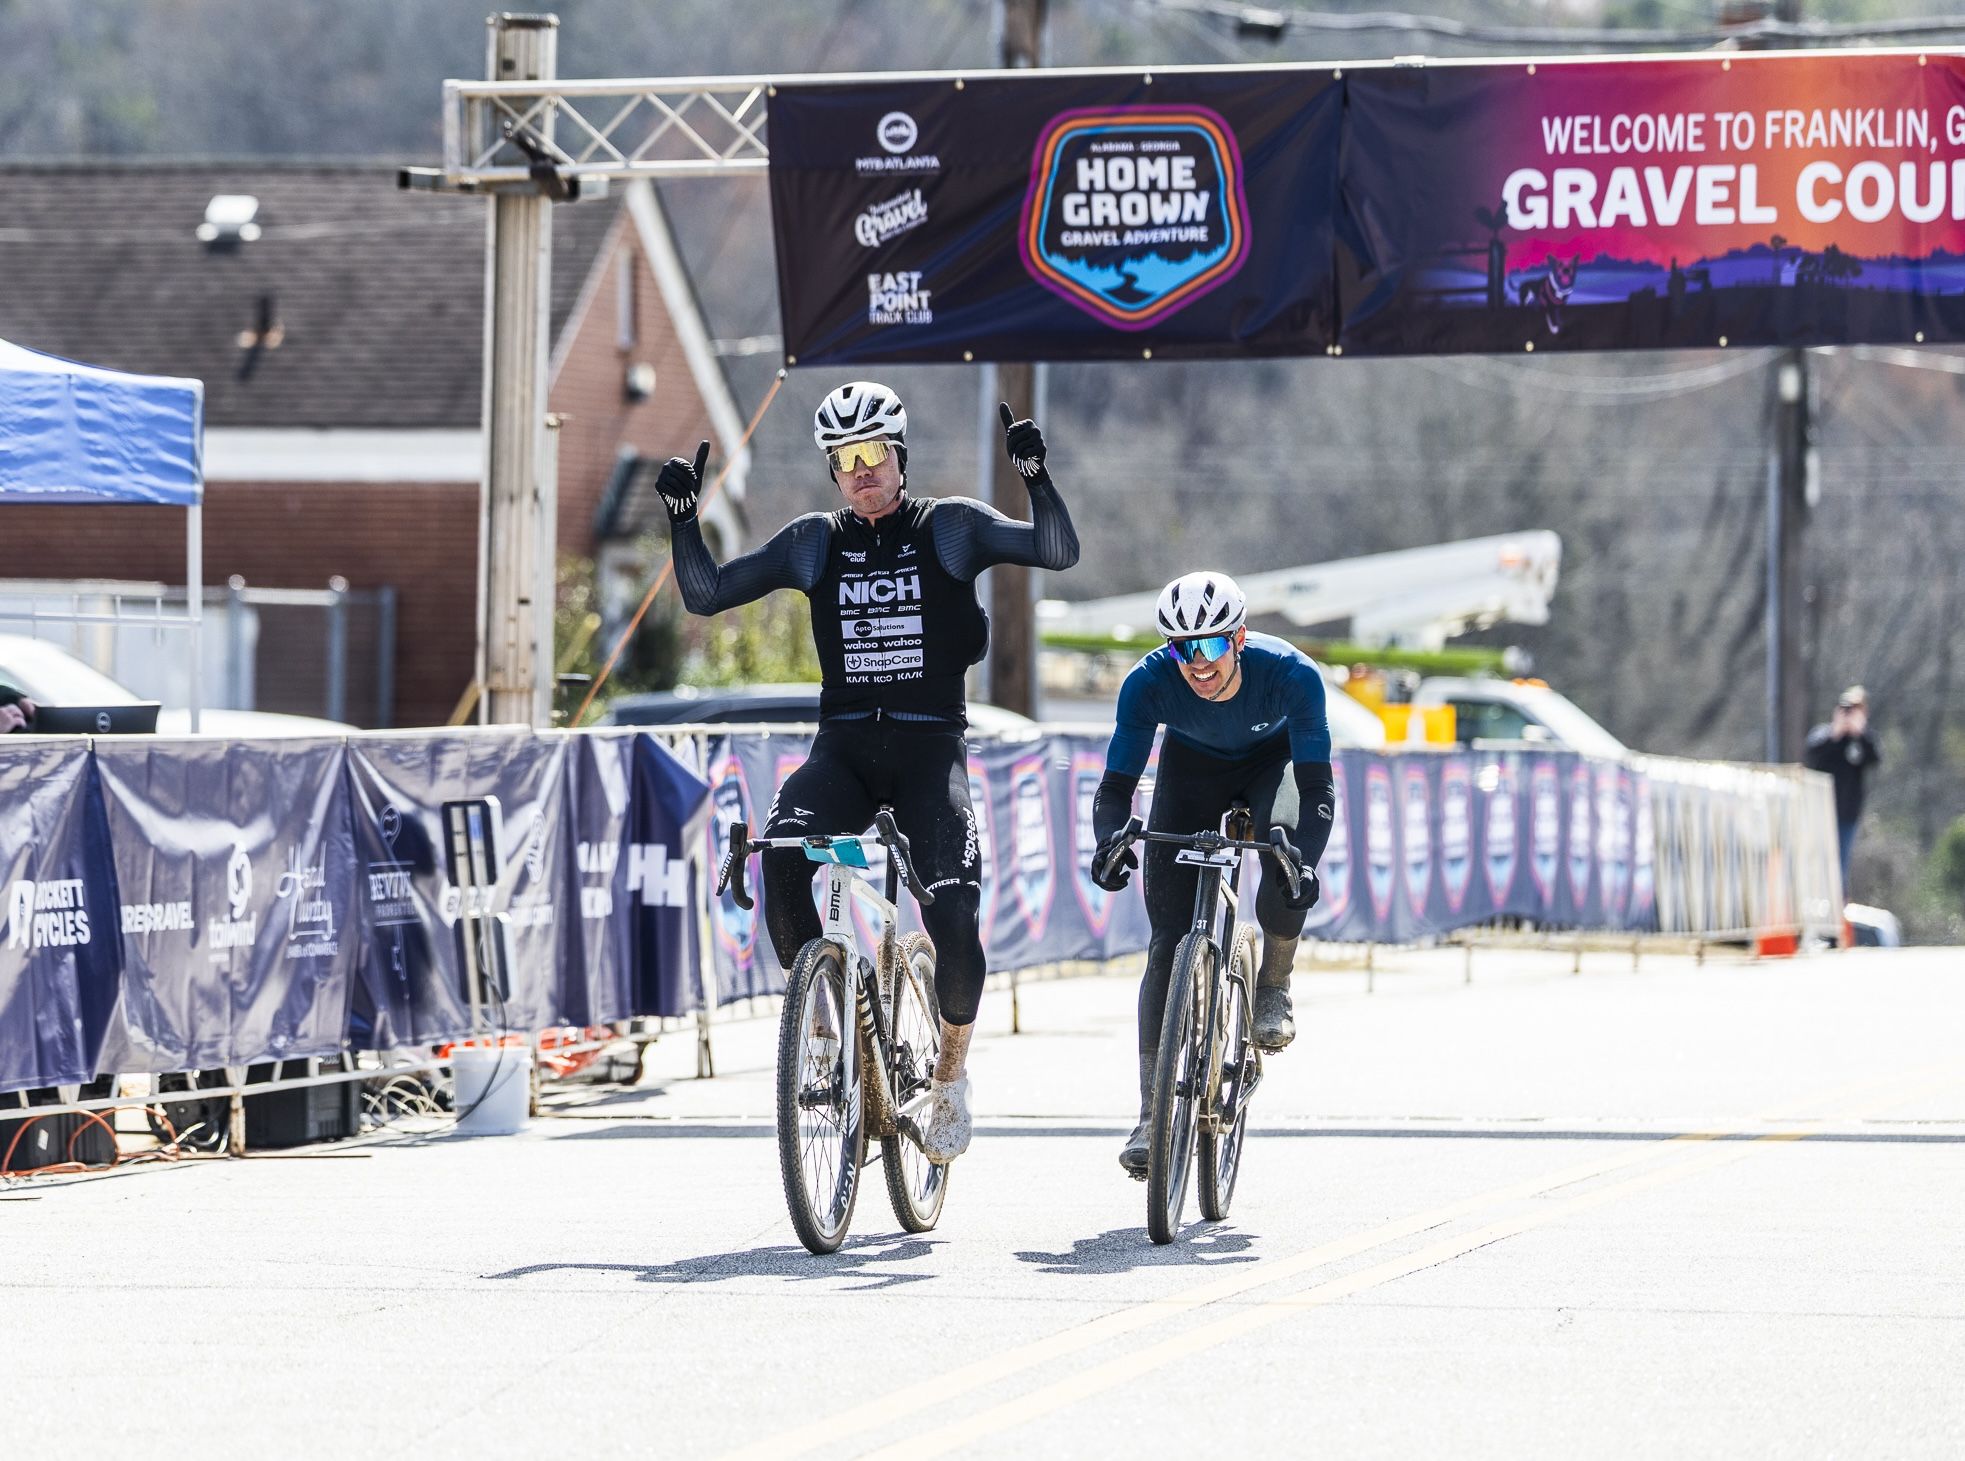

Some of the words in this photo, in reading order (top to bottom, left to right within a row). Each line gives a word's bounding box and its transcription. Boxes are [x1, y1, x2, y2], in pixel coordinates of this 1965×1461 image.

[1541, 112, 1706, 155] WELCOME
[1713, 110, 1757, 151] TO
[1764, 107, 1938, 154] FRANKLIN,
[1076, 155, 1197, 192] HOME
[1502, 164, 1778, 230] GRAVEL
[1061, 191, 1211, 227] GROWN
[1060, 230, 1121, 248] GRAVEL
[1122, 225, 1209, 246] ADVENTURE
[867, 271, 923, 293] EAST
[869, 289, 932, 312] POINT
[869, 310, 904, 325] TRACK
[904, 309, 933, 325] CLUB
[838, 574, 922, 606] NICH
[840, 609, 861, 617] BMC
[897, 604, 922, 612] BMC
[855, 625, 872, 633] Apto
[872, 623, 905, 632] Solutions
[843, 640, 879, 650] wahoo
[882, 637, 922, 648] wahoo
[863, 655, 922, 669] SnapCare
[897, 671, 923, 681] KASK
[829, 880, 841, 921] BMC
[33, 909, 91, 948] CYCLES
[1196, 919, 1208, 930] 3T
